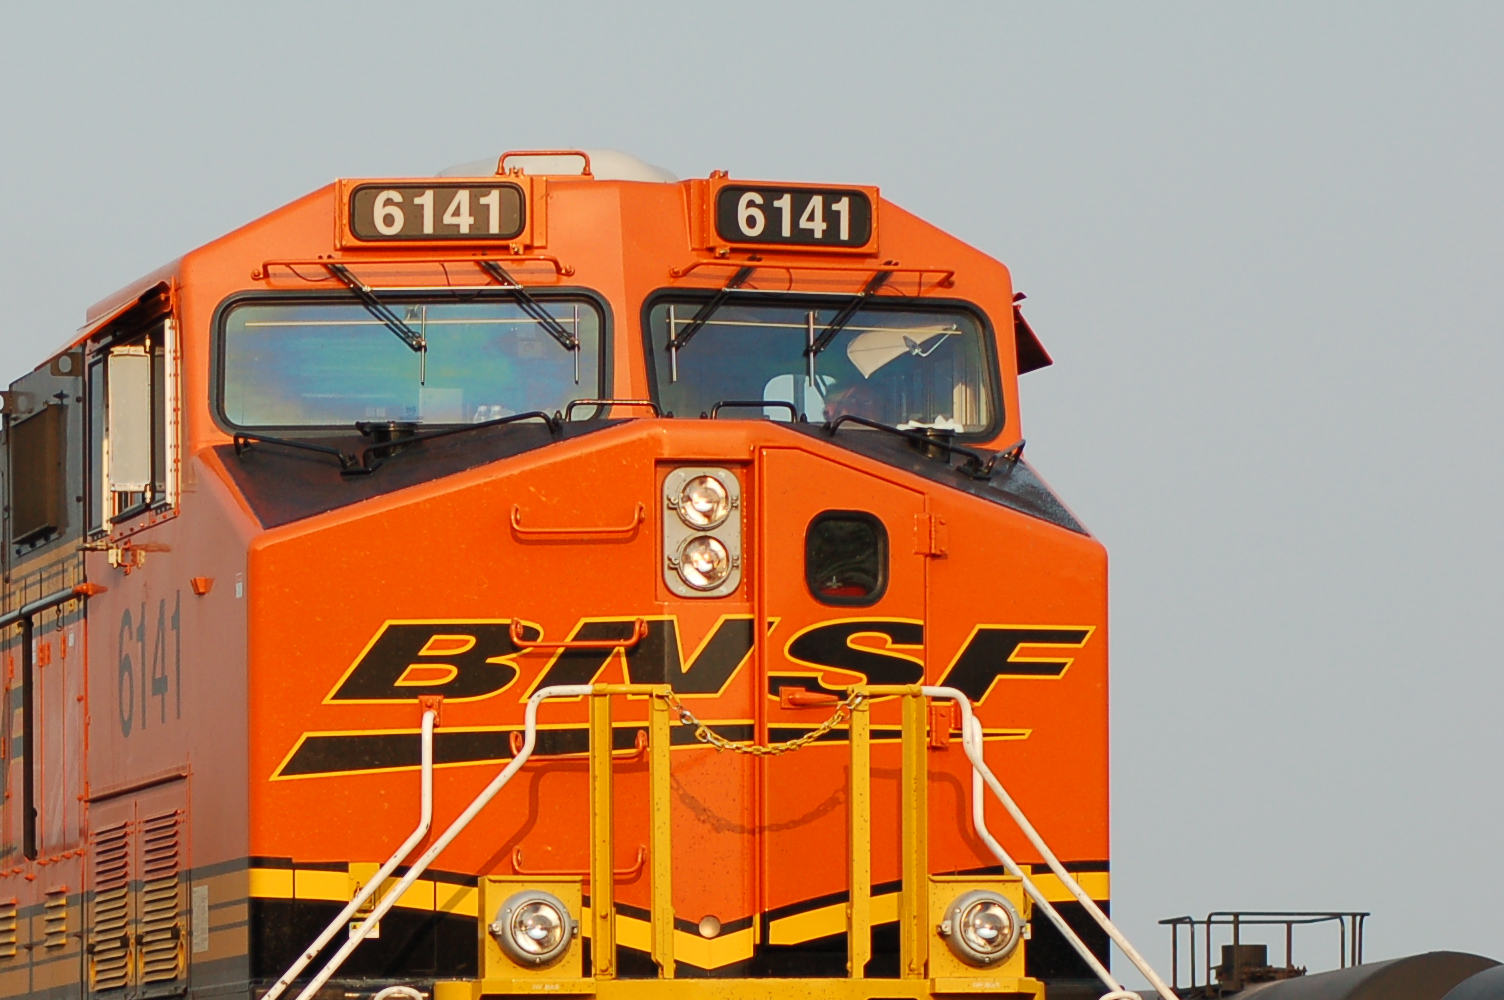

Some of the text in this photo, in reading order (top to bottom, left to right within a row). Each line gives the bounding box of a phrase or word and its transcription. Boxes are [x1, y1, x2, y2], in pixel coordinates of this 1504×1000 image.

[373, 189, 500, 236] 6141
[737, 191, 849, 241] 6141
[118, 590, 181, 738] 6141
[322, 614, 1097, 707] BNSF
